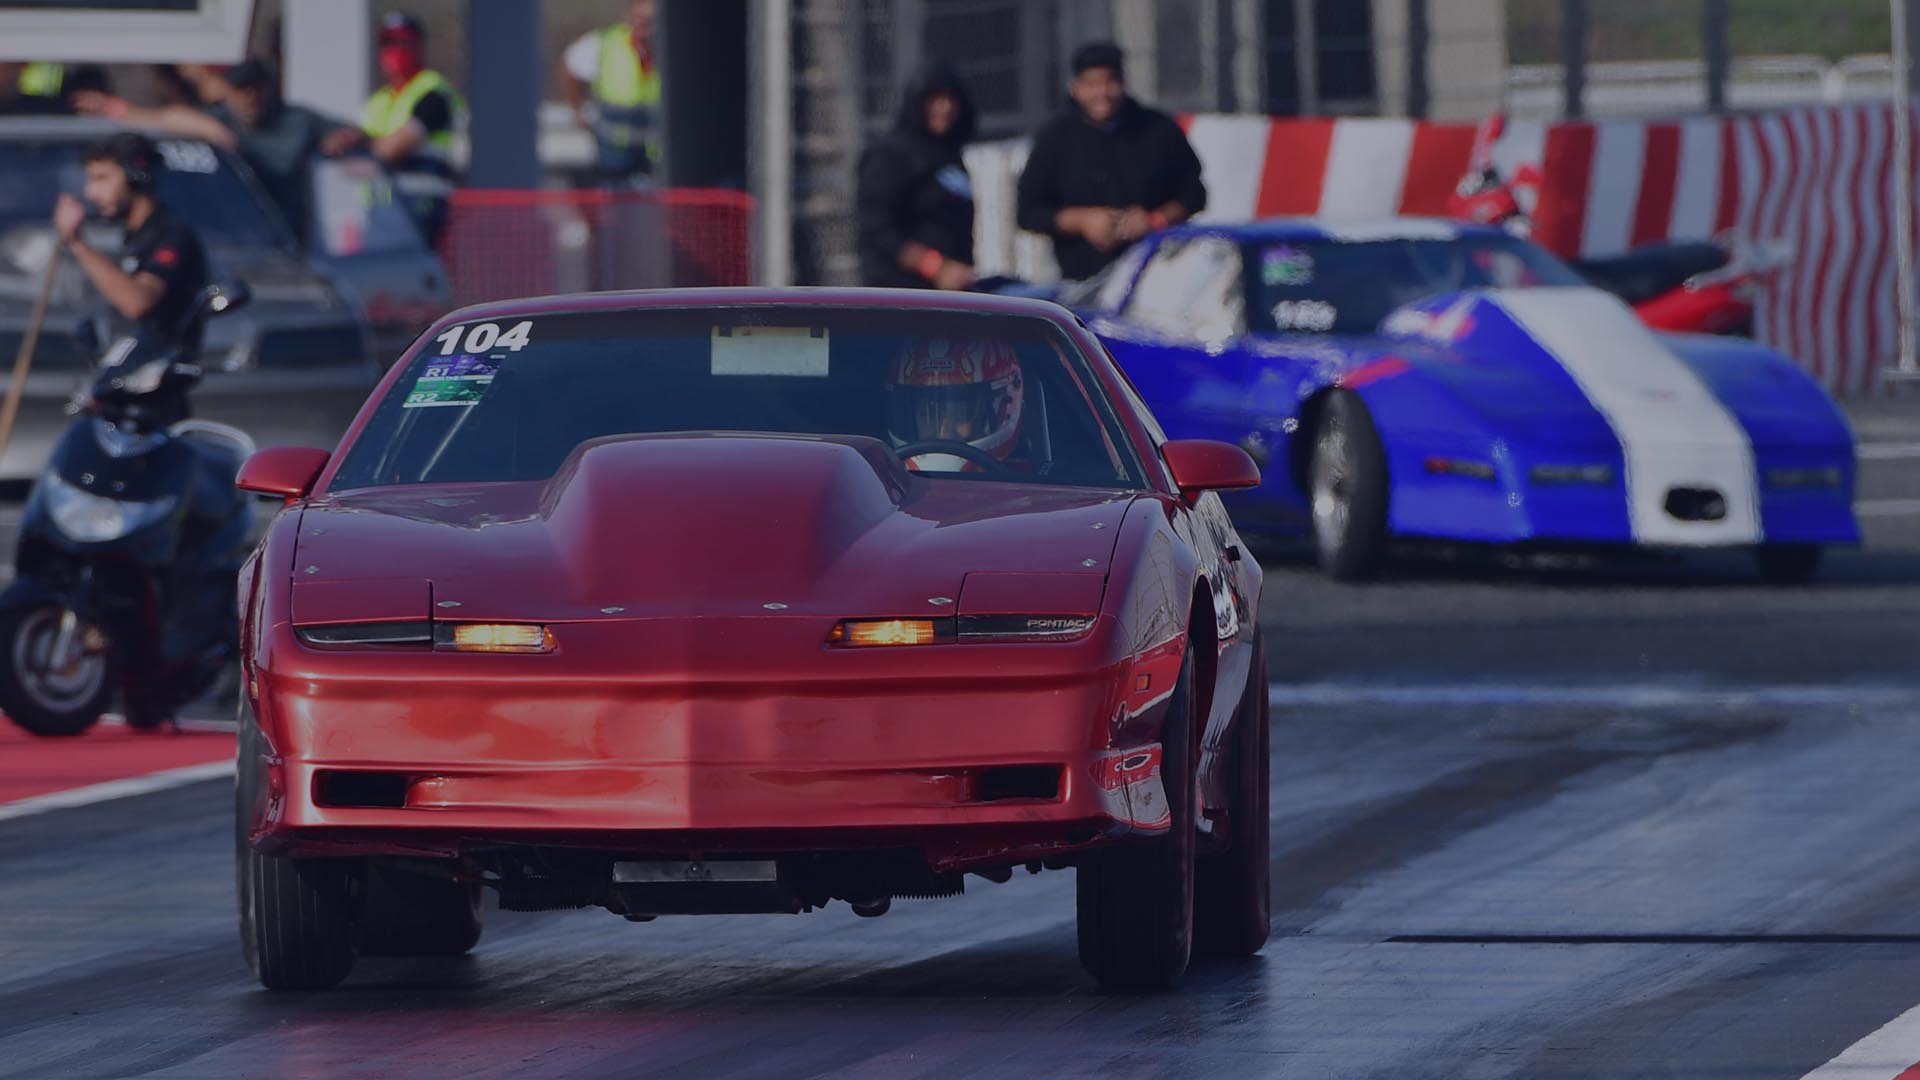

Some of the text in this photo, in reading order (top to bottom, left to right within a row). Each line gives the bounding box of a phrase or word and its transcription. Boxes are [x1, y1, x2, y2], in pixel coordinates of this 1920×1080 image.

[437, 321, 534, 355] 104
[425, 367, 450, 377] R1
[408, 393, 438, 404] R2
[1027, 619, 1087, 628] PONTIAC
